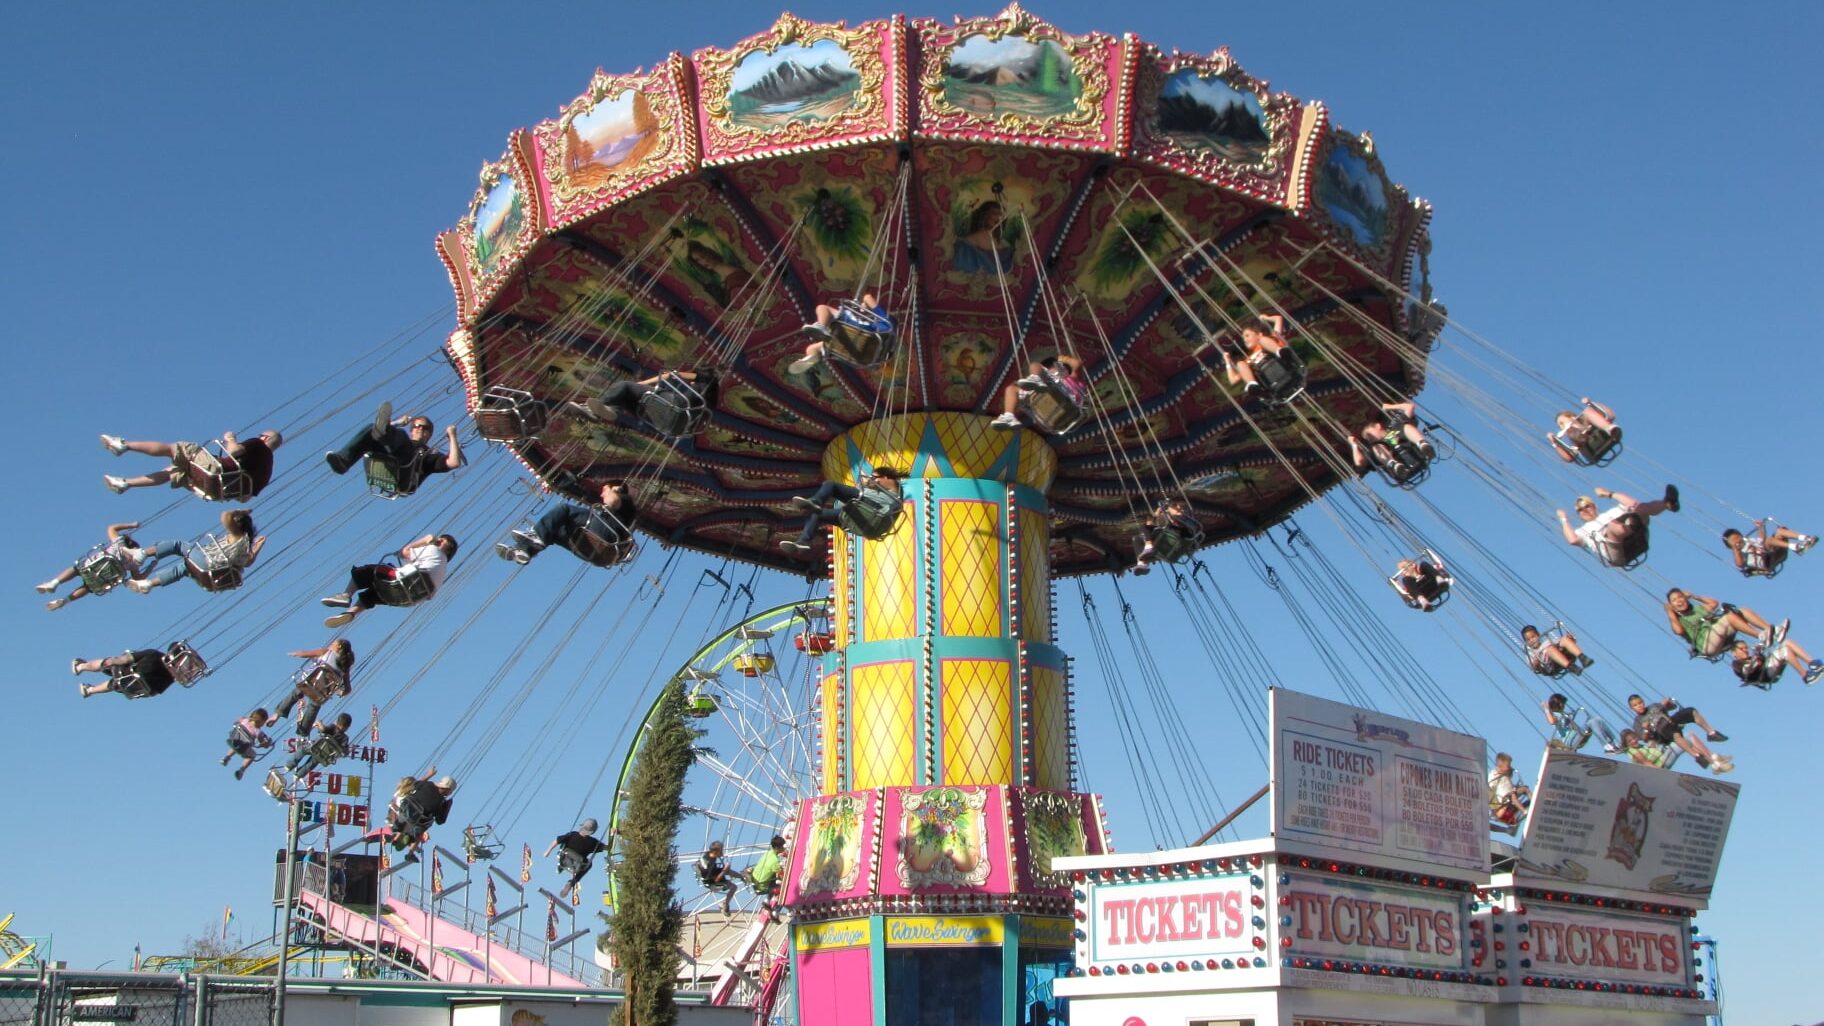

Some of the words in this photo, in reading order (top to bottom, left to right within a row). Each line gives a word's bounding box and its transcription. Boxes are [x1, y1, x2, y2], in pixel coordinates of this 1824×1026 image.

[350, 744, 386, 763] FAIR
[1293, 740, 1322, 766] RIDE
[1325, 747, 1375, 776] TICKETS
[308, 771, 362, 797] FUN
[1311, 780, 1339, 795] TICKETS
[1342, 786, 1356, 798] FOR
[1339, 773, 1364, 787] EACH
[1400, 762, 1432, 789] CUPONES
[1435, 770, 1453, 794] PARA
[1311, 792, 1341, 807] TICKETS
[1344, 798, 1357, 810] FOR
[1413, 800, 1444, 814] BOLETOS
[1424, 790, 1443, 805] CADA
[1445, 795, 1473, 810] BOLETO
[299, 800, 369, 827] SLIDE
[1412, 811, 1443, 827] BOLETOS
[1445, 818, 1459, 830] POR
[1103, 890, 1245, 946] TICKETS
[1290, 890, 1456, 956] TICKETS
[890, 921, 930, 942] Wave
[930, 919, 991, 943] Swinger
[1529, 920, 1681, 975] TICKETS
[80, 1006, 132, 1017] AMERICAN
